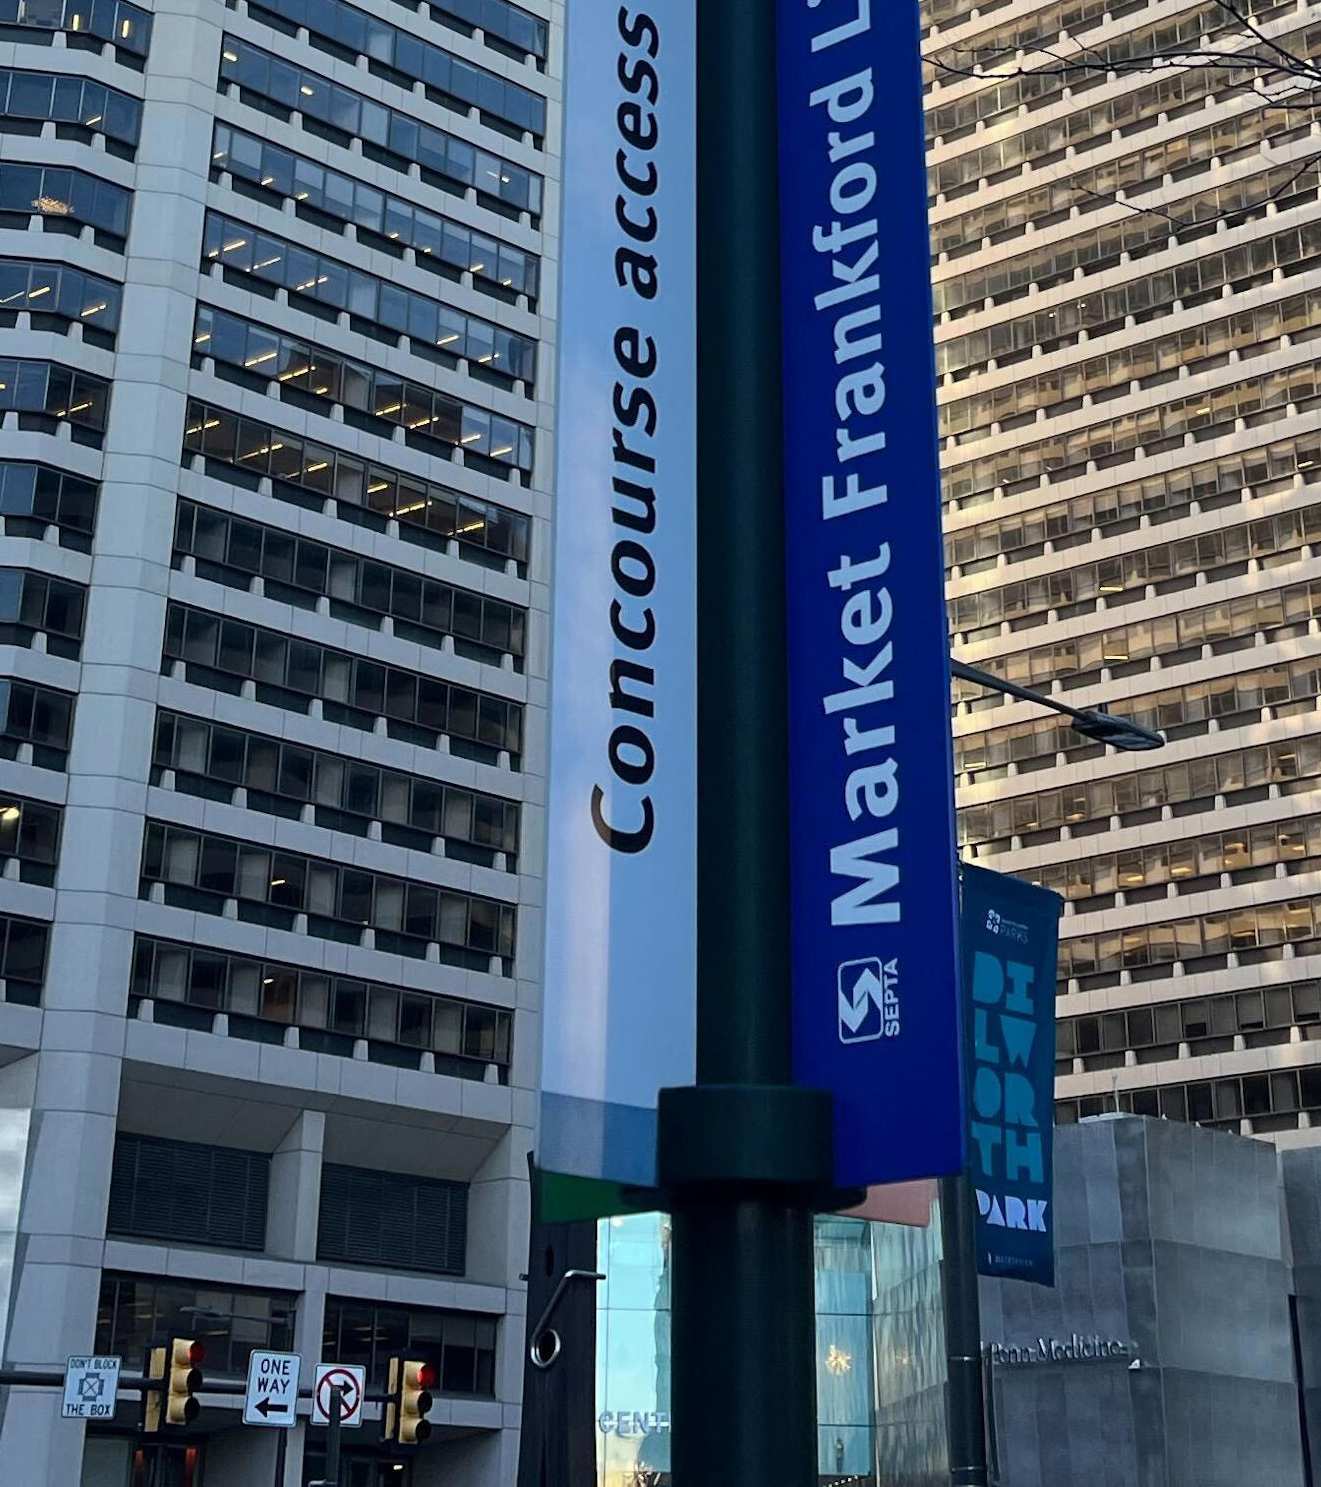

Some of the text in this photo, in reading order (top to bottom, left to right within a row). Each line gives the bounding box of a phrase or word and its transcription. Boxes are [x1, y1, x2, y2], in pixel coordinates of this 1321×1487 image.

[809, 66, 888, 521] Frankford
[590, 4, 659, 855] Concourse access
[822, 541, 901, 926] Market
[882, 957, 900, 1037] SEPTA
[975, 1188, 1047, 1233] PARK
[70, 1358, 118, 1370] DON'T BLOCK
[257, 1377, 291, 1395] WAY
[260, 1358, 291, 1376] ONE
[66, 1404, 111, 1416] THE BOX
